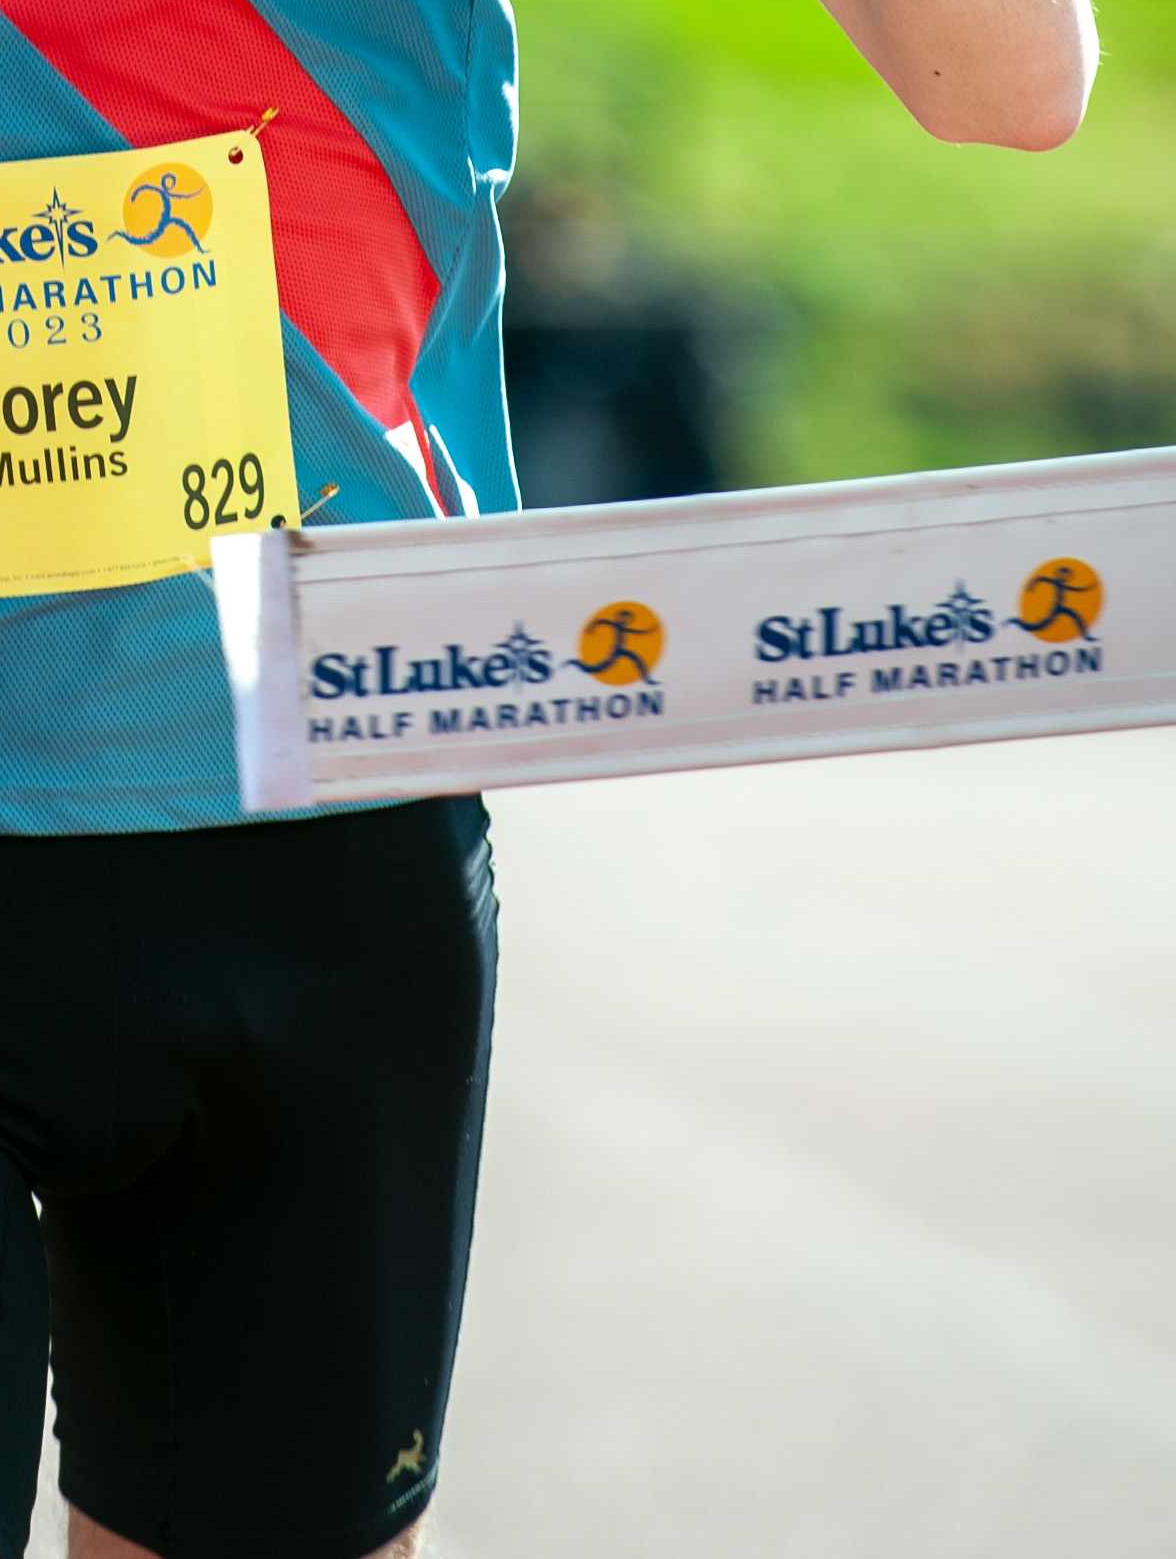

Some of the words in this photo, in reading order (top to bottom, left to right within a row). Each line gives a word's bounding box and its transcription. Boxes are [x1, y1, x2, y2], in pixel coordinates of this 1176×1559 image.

[182, 452, 266, 530] 829
[752, 671, 857, 705] HALF
[869, 645, 1105, 694] MARATHON
[308, 710, 416, 744] HALF
[426, 690, 665, 735] MARATHON
